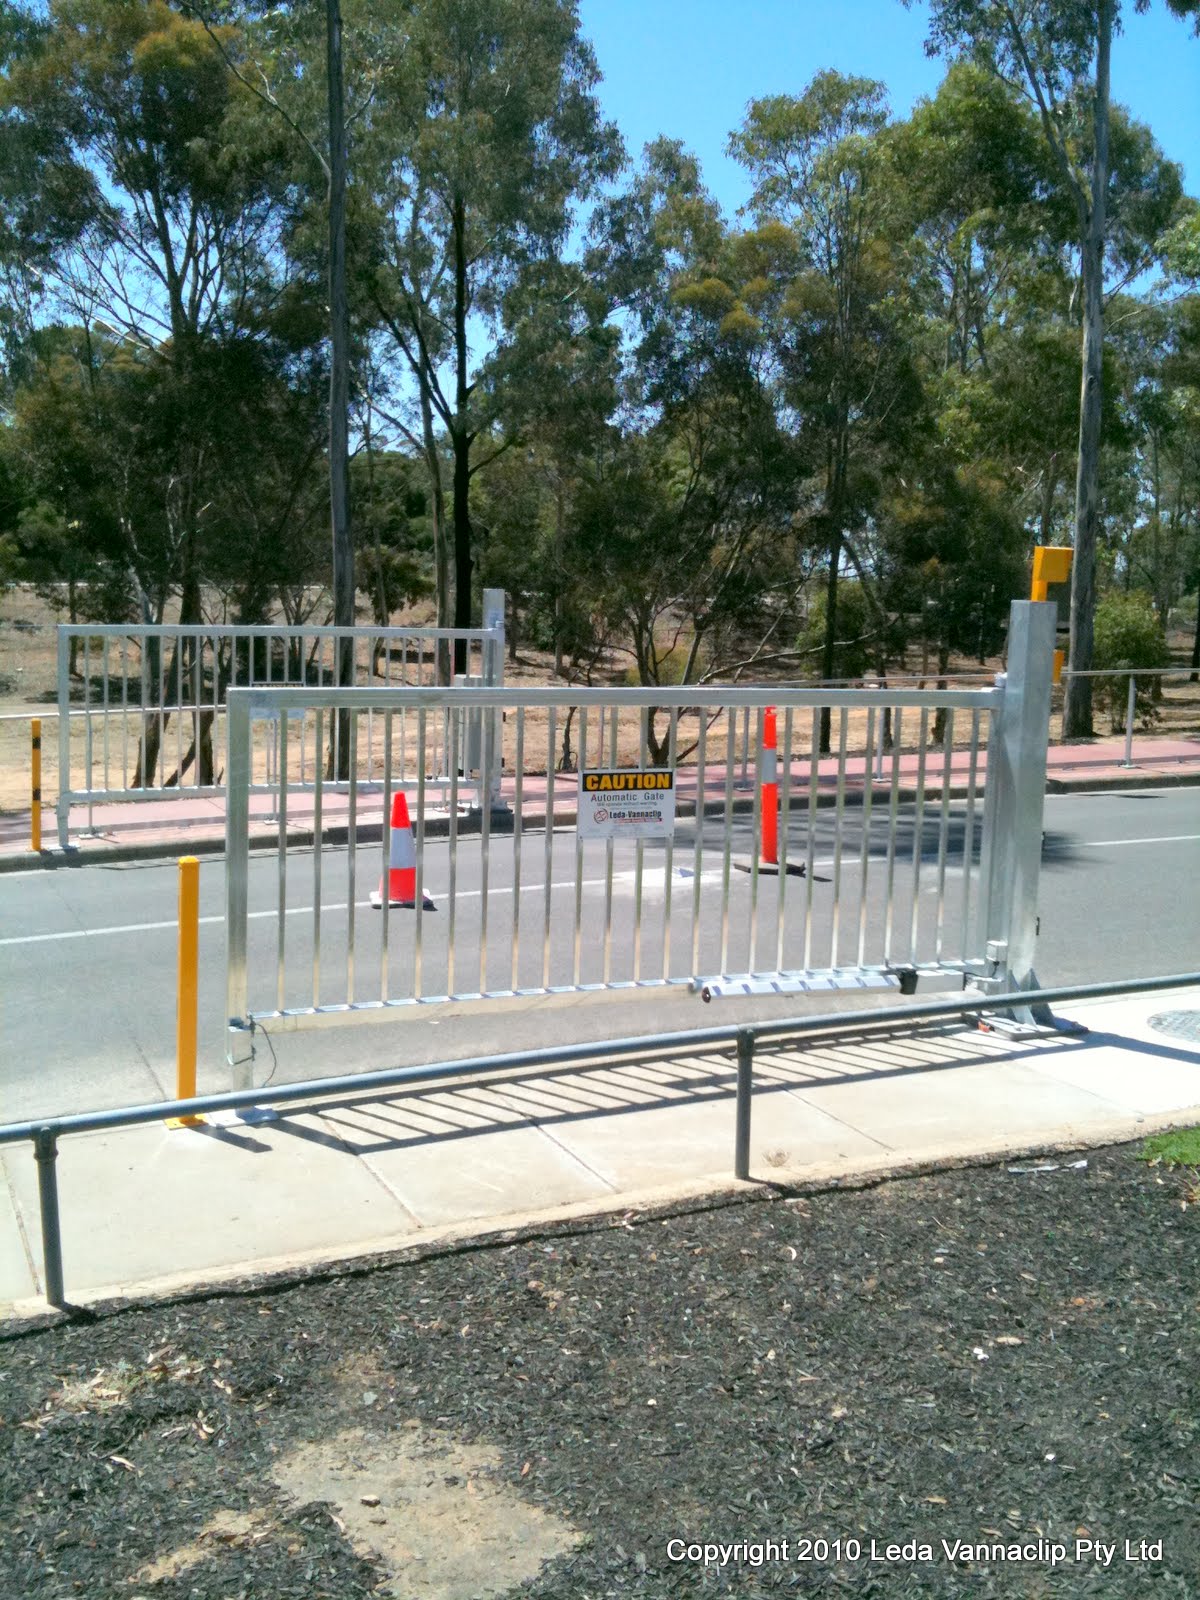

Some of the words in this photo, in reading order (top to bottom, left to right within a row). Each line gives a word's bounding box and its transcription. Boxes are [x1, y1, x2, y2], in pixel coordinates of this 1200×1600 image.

[586, 773, 670, 790] CAUTION
[591, 793, 638, 802] Automatic
[644, 792, 665, 801] Gate
